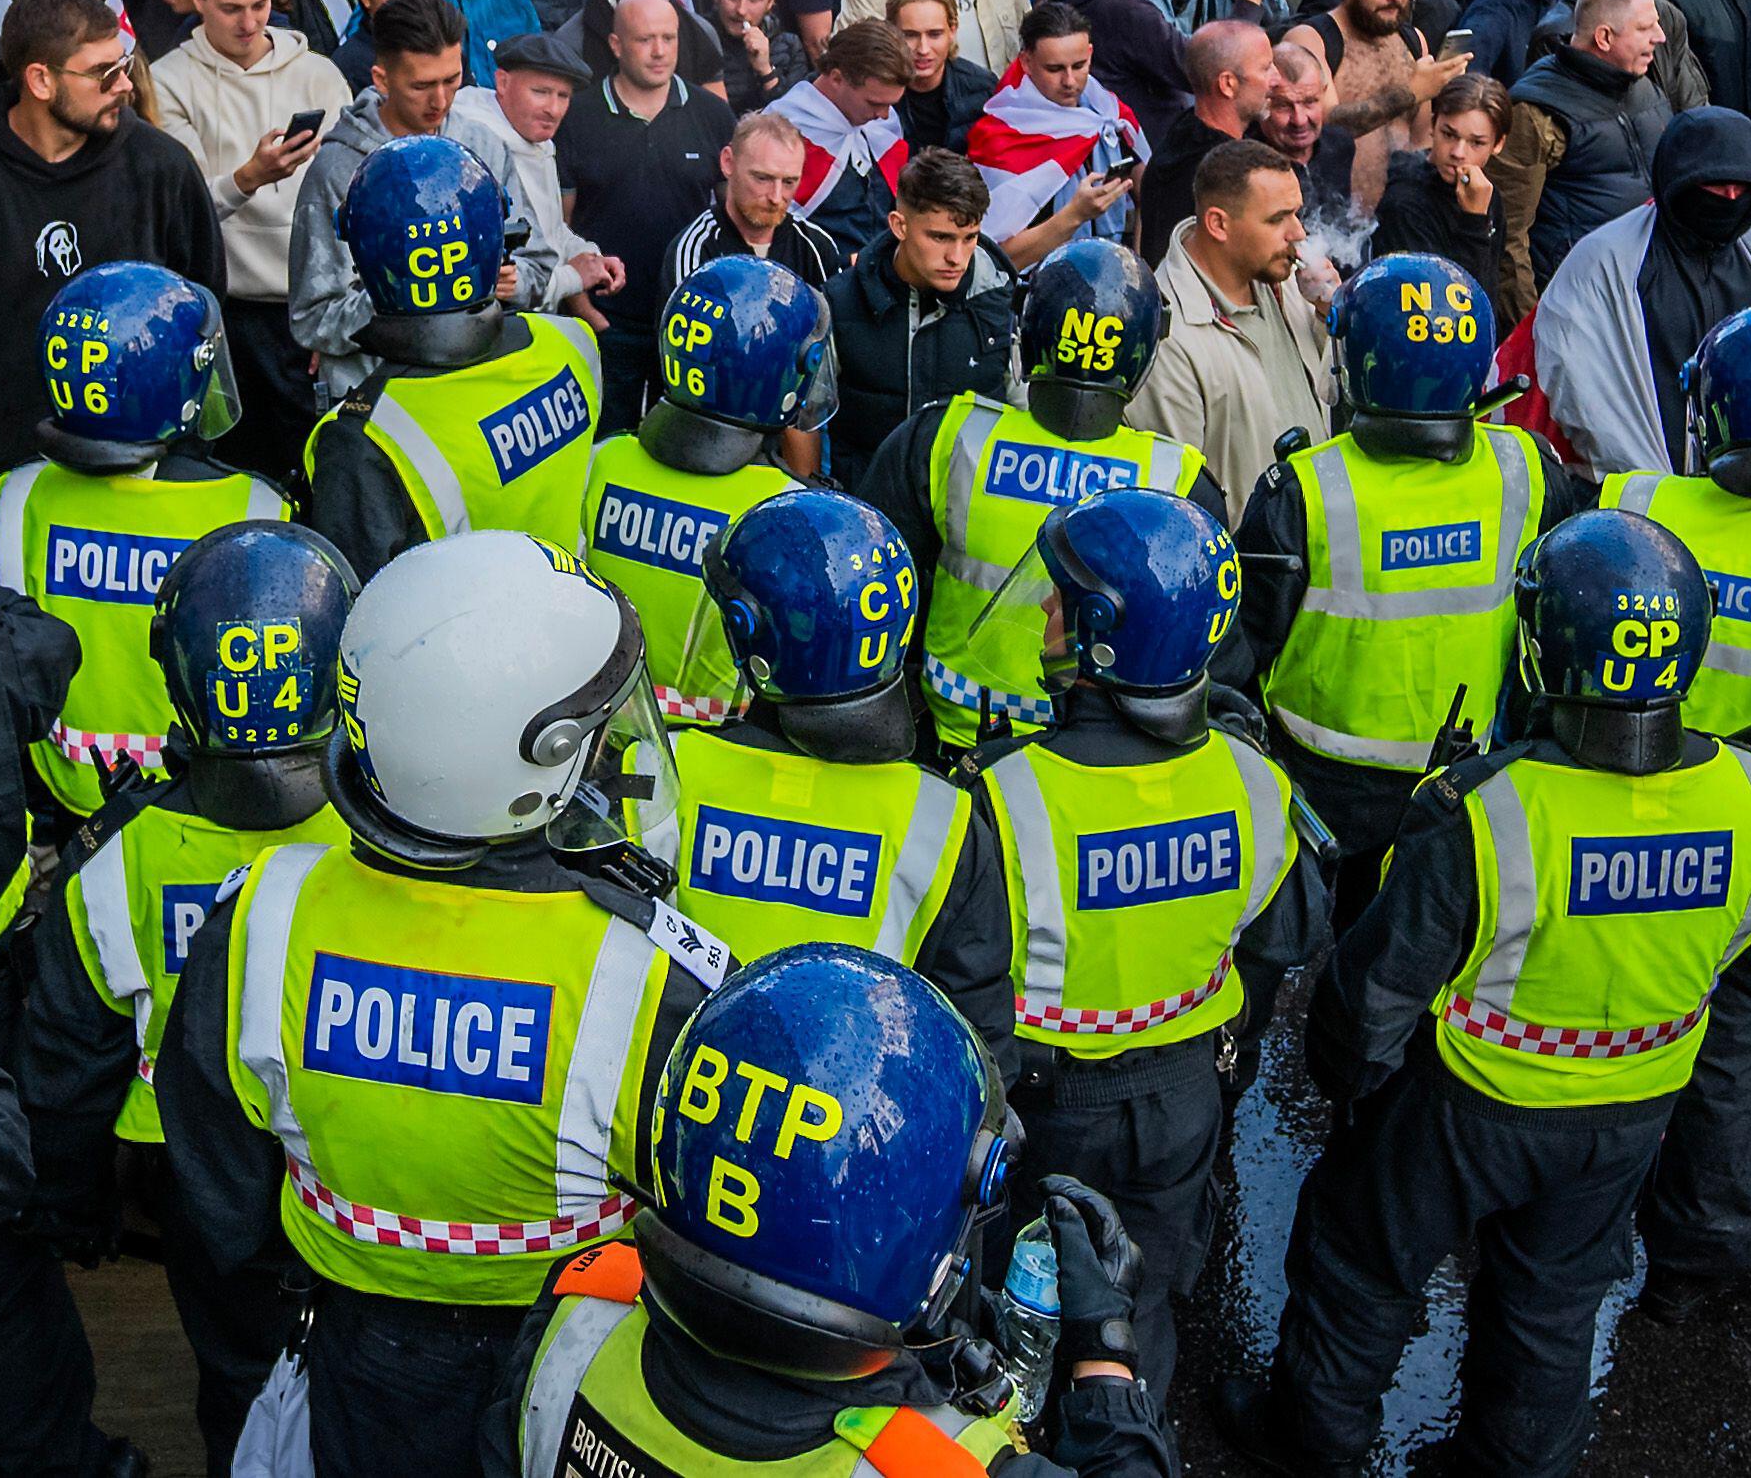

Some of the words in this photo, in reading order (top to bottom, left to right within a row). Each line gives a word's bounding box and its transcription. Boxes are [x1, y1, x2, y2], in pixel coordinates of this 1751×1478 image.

[408, 215, 462, 240] 3731
[408, 241, 469, 279] CP
[56, 312, 109, 333] 3254
[681, 291, 725, 320] 2778
[667, 312, 713, 353] CP
[1060, 307, 1124, 349] NC
[1407, 314, 1477, 344] 830
[1058, 336, 1115, 372] 513
[491, 376, 588, 470] POLICE
[599, 494, 719, 566] POLICE
[1389, 529, 1472, 563] POLICE
[53, 537, 184, 595] POLIC
[850, 535, 907, 572] 3421
[858, 565, 914, 623] CP
[1617, 595, 1676, 612] 3248
[219, 624, 300, 673] CP
[1612, 619, 1681, 659] CP
[1602, 659, 1636, 692] U
[1654, 660, 1679, 690] 4
[215, 680, 249, 719] U
[273, 675, 302, 712] 4
[227, 722, 299, 744] 3226
[700, 821, 870, 907] POLICE
[1087, 827, 1233, 898] POLICE
[1579, 840, 1727, 910] POLICE
[314, 976, 537, 1082] POLICE
[679, 1043, 844, 1161] BTP
[705, 1155, 761, 1239] B
